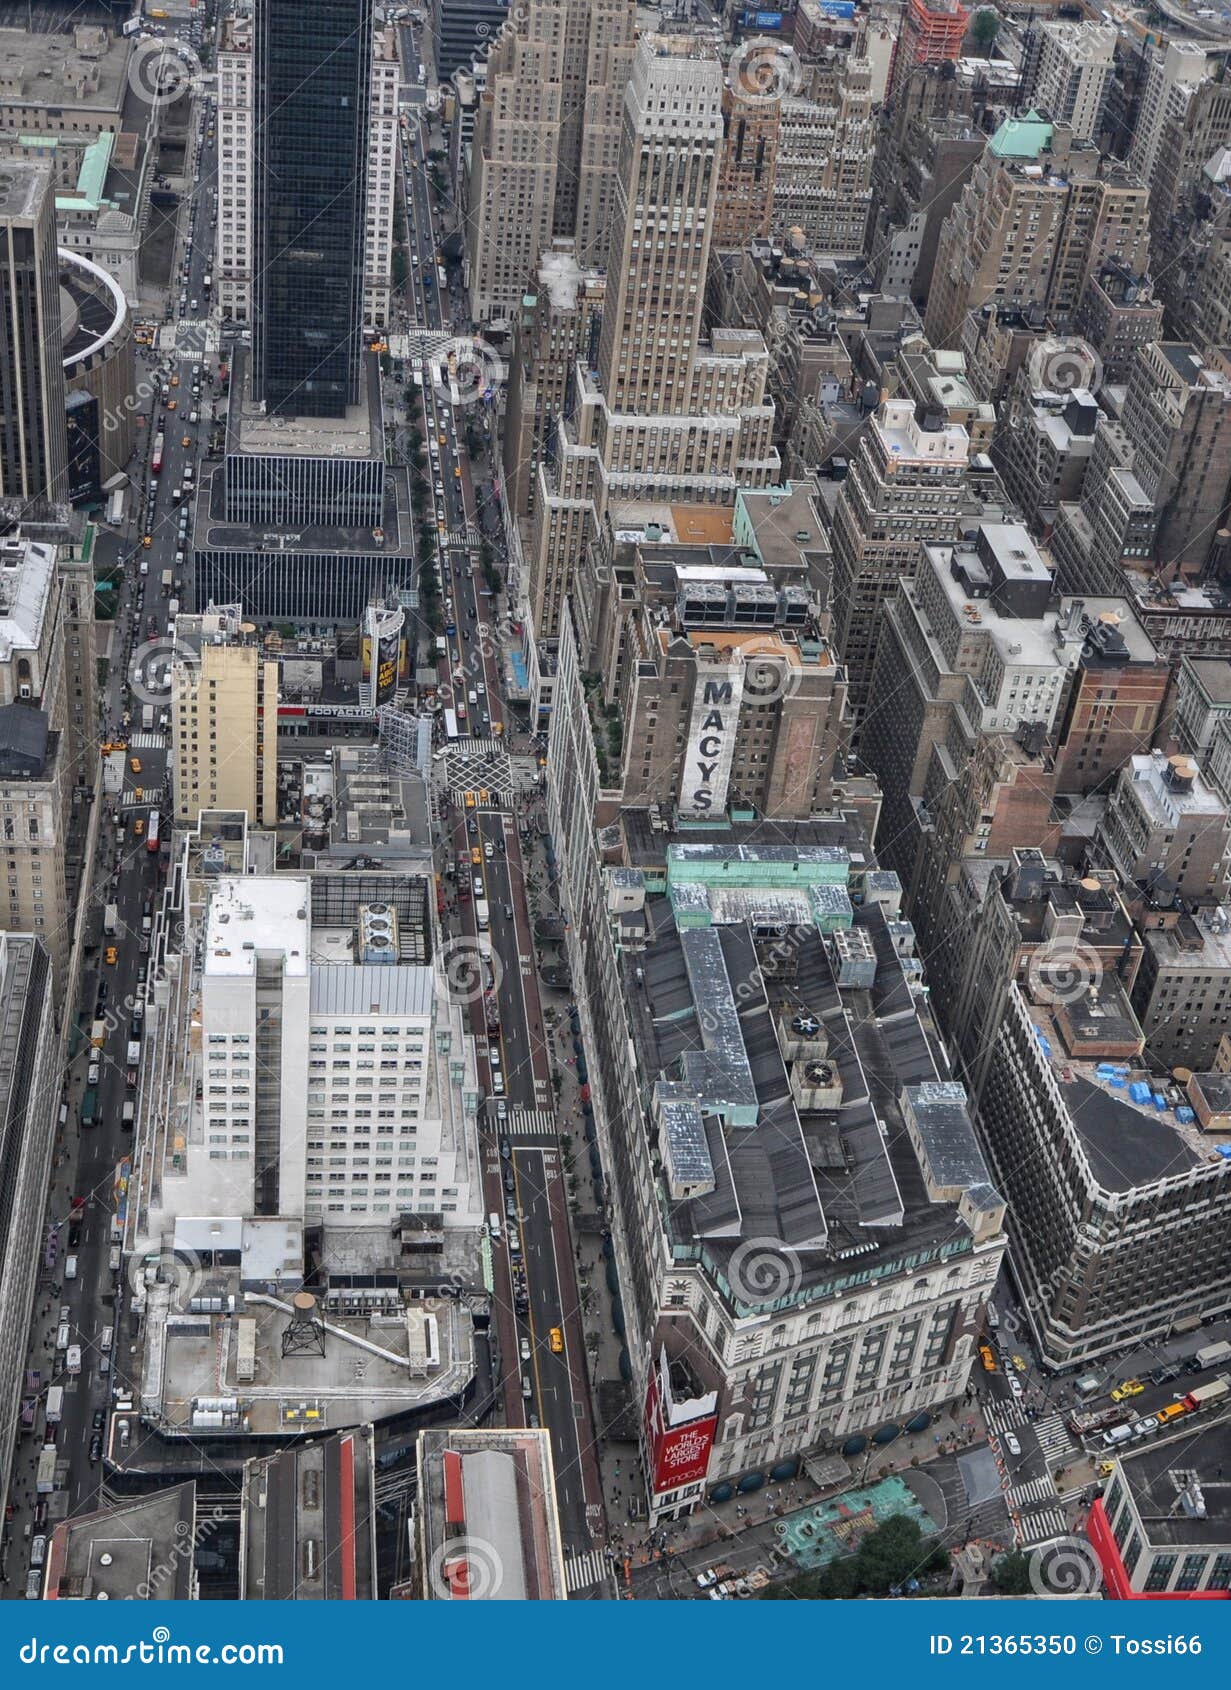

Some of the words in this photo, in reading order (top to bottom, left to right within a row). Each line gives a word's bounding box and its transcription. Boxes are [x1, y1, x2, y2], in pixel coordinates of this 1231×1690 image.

[692, 681, 733, 811] MACYS
[665, 1433, 709, 1454] WORLD'S
[680, 1430, 699, 1443] THE
[664, 1441, 707, 1463] LARGEST
[670, 1451, 700, 1468] STORE
